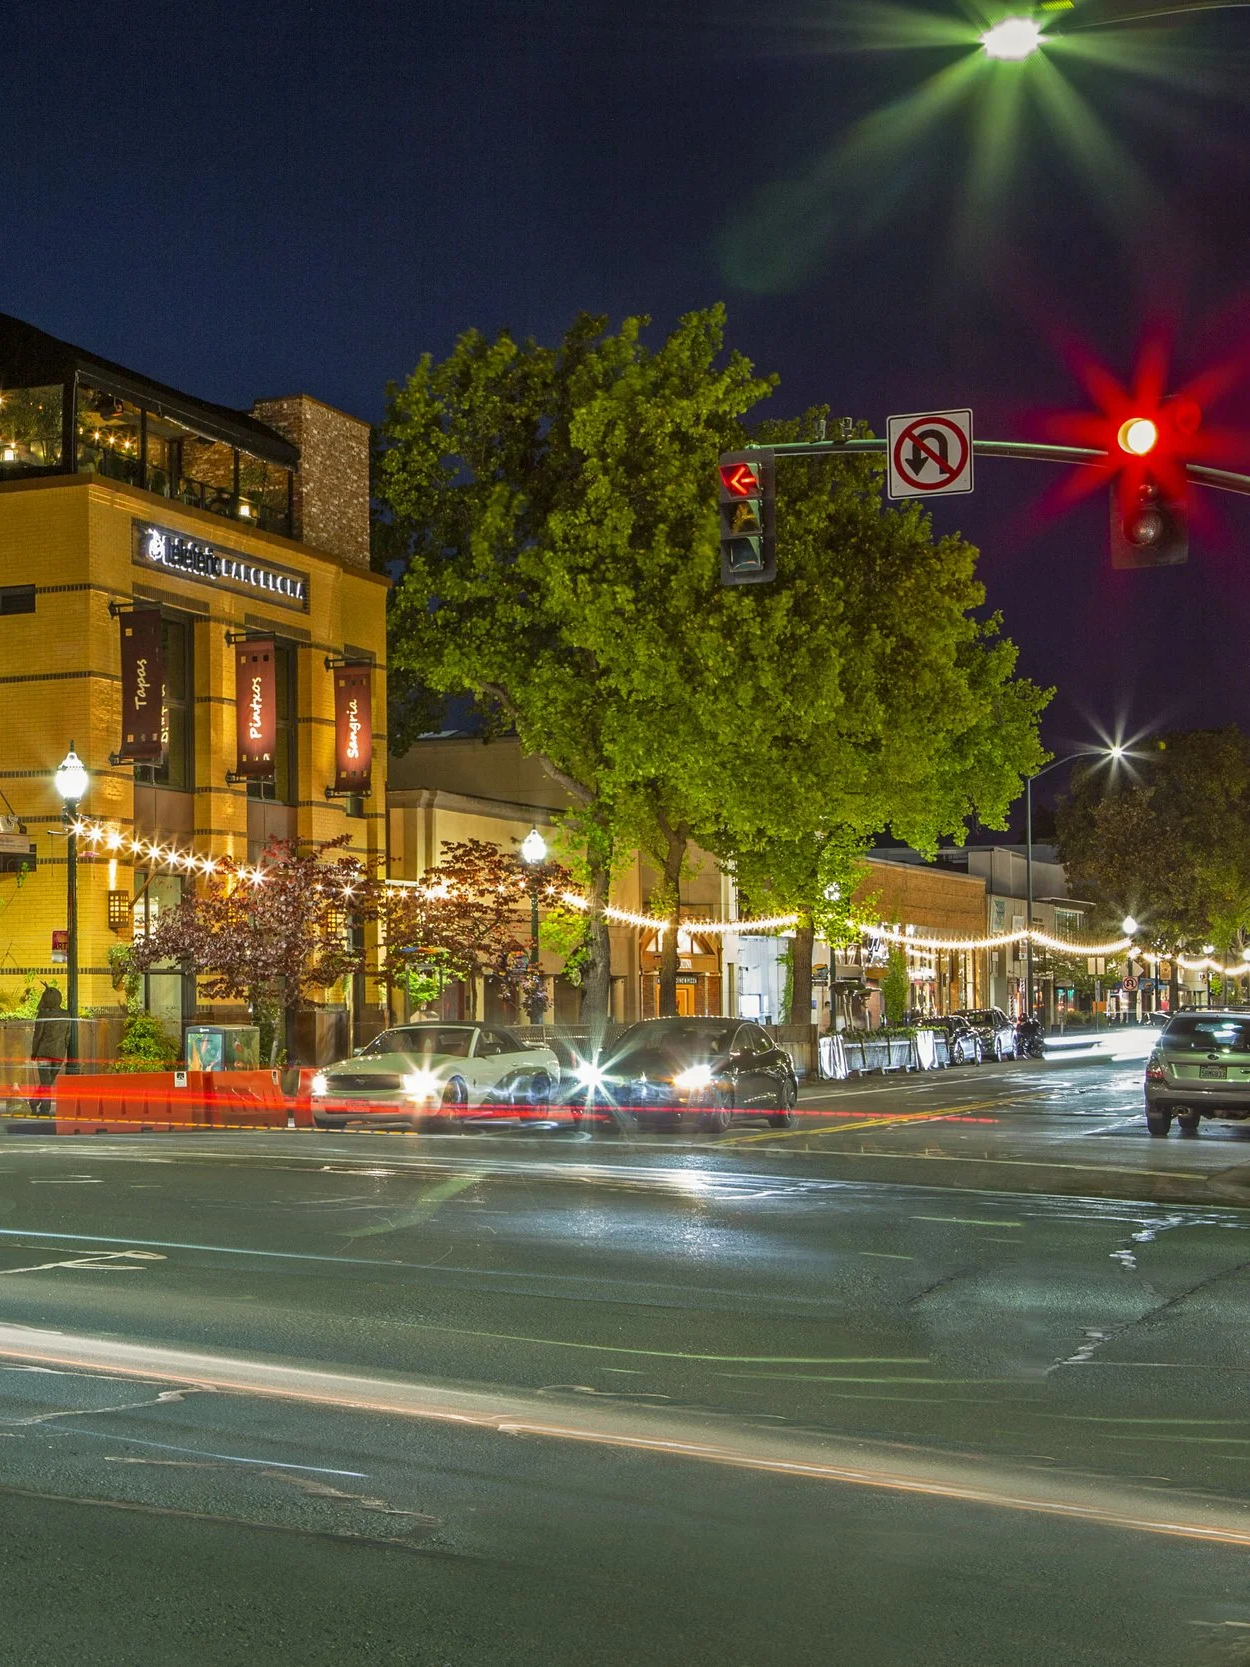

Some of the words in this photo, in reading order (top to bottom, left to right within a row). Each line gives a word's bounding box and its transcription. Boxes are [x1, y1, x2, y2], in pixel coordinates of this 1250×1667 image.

[135, 658, 151, 711] Tapas
[249, 677, 263, 740] Pintxos
[347, 699, 361, 758] Sangria
